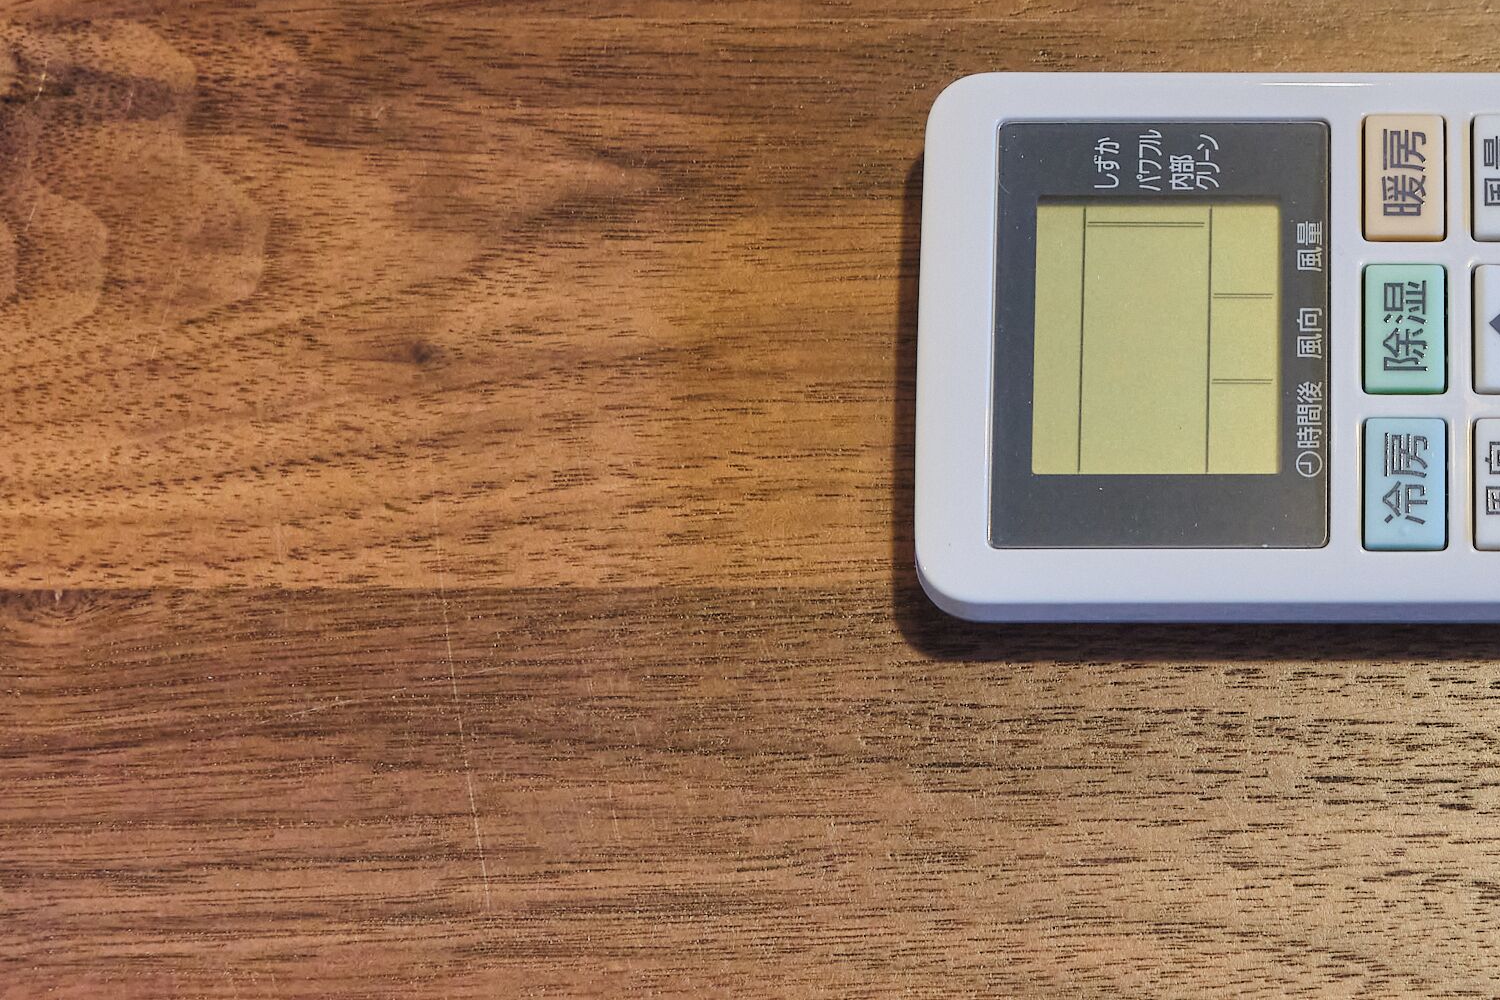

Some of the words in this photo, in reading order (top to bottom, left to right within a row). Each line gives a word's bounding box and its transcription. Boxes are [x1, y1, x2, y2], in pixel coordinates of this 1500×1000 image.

[1094, 137, 1120, 190] しずか
[1137, 130, 1162, 191] パワフル
[1169, 154, 1195, 191] 内部
[1196, 134, 1220, 190] クリーン
[1382, 128, 1427, 217] 暖房
[1297, 221, 1323, 272] 風量
[1297, 307, 1322, 359] 風向
[1382, 279, 1429, 372] 除湿
[1382, 431, 1429, 526] 冷房
